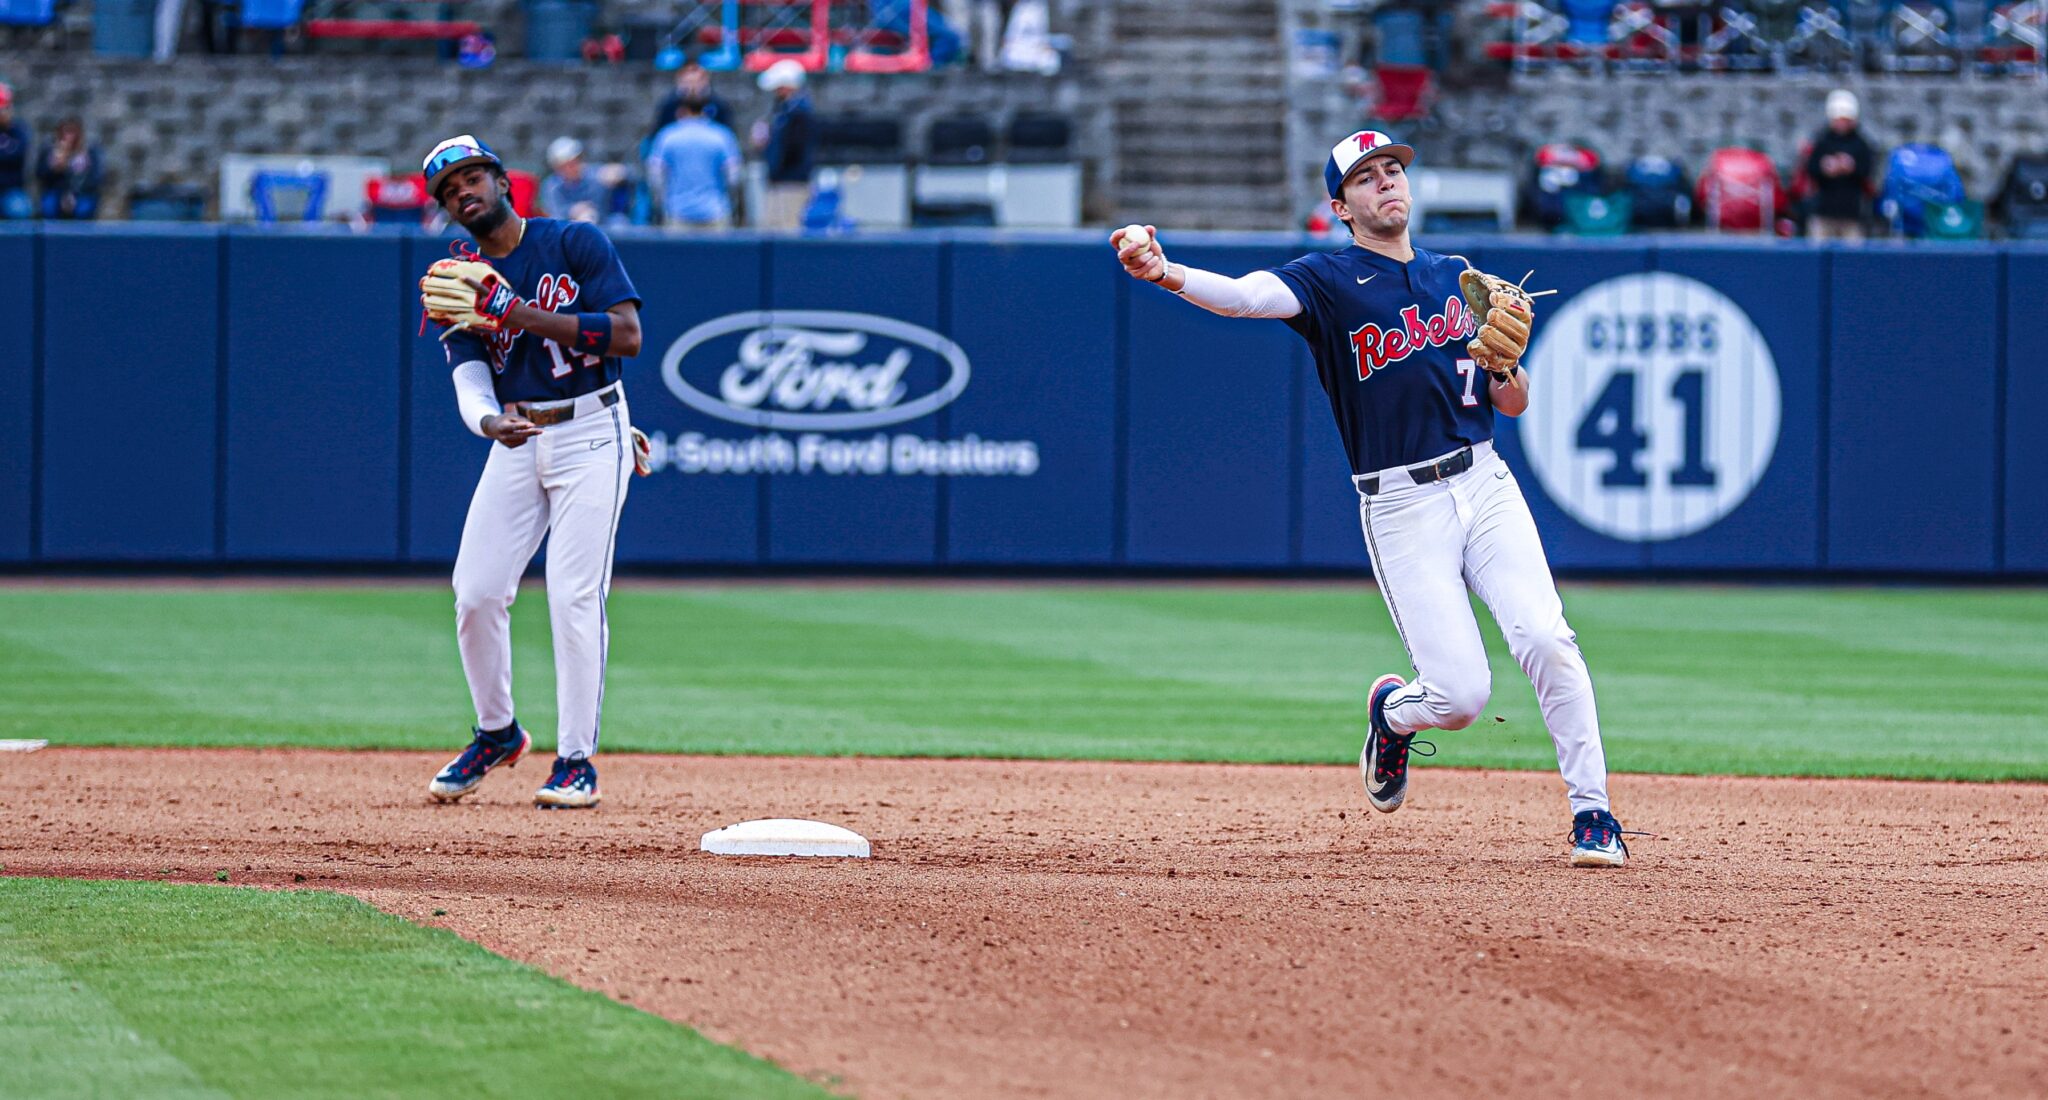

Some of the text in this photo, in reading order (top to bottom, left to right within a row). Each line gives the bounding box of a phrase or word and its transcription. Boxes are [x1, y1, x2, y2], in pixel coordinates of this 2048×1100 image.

[1349, 295, 1477, 382] Rebels
[1585, 314, 1719, 353] GIBBS
[719, 328, 912, 411] Ford
[1455, 358, 1479, 406] 7
[798, 431, 888, 476] Ford
[892, 432, 1040, 476] Dealers
[1573, 366, 1718, 488] 41
